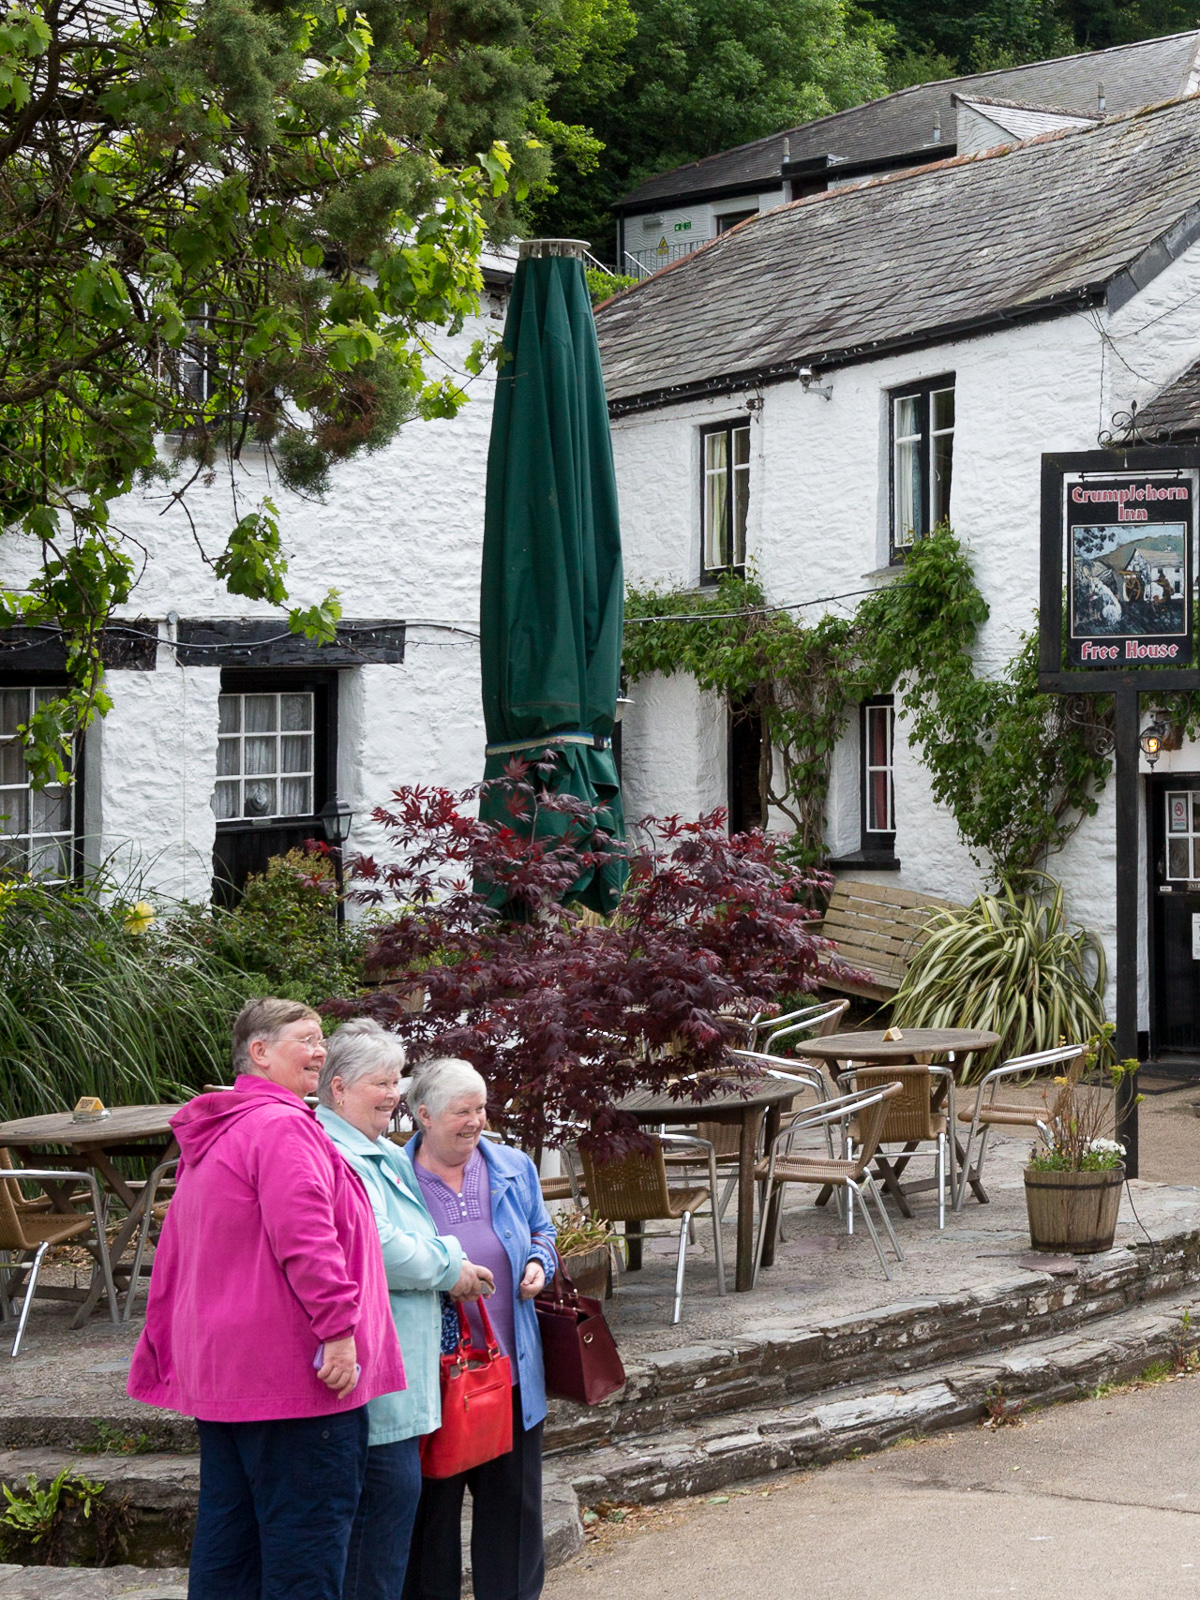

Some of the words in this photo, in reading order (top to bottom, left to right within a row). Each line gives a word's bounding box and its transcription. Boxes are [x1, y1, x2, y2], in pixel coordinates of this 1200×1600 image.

[1071, 484, 1189, 504] Crumplehorn
[1117, 504, 1148, 521] Inn
[1081, 641, 1120, 660] Free
[1125, 640, 1179, 660] House
